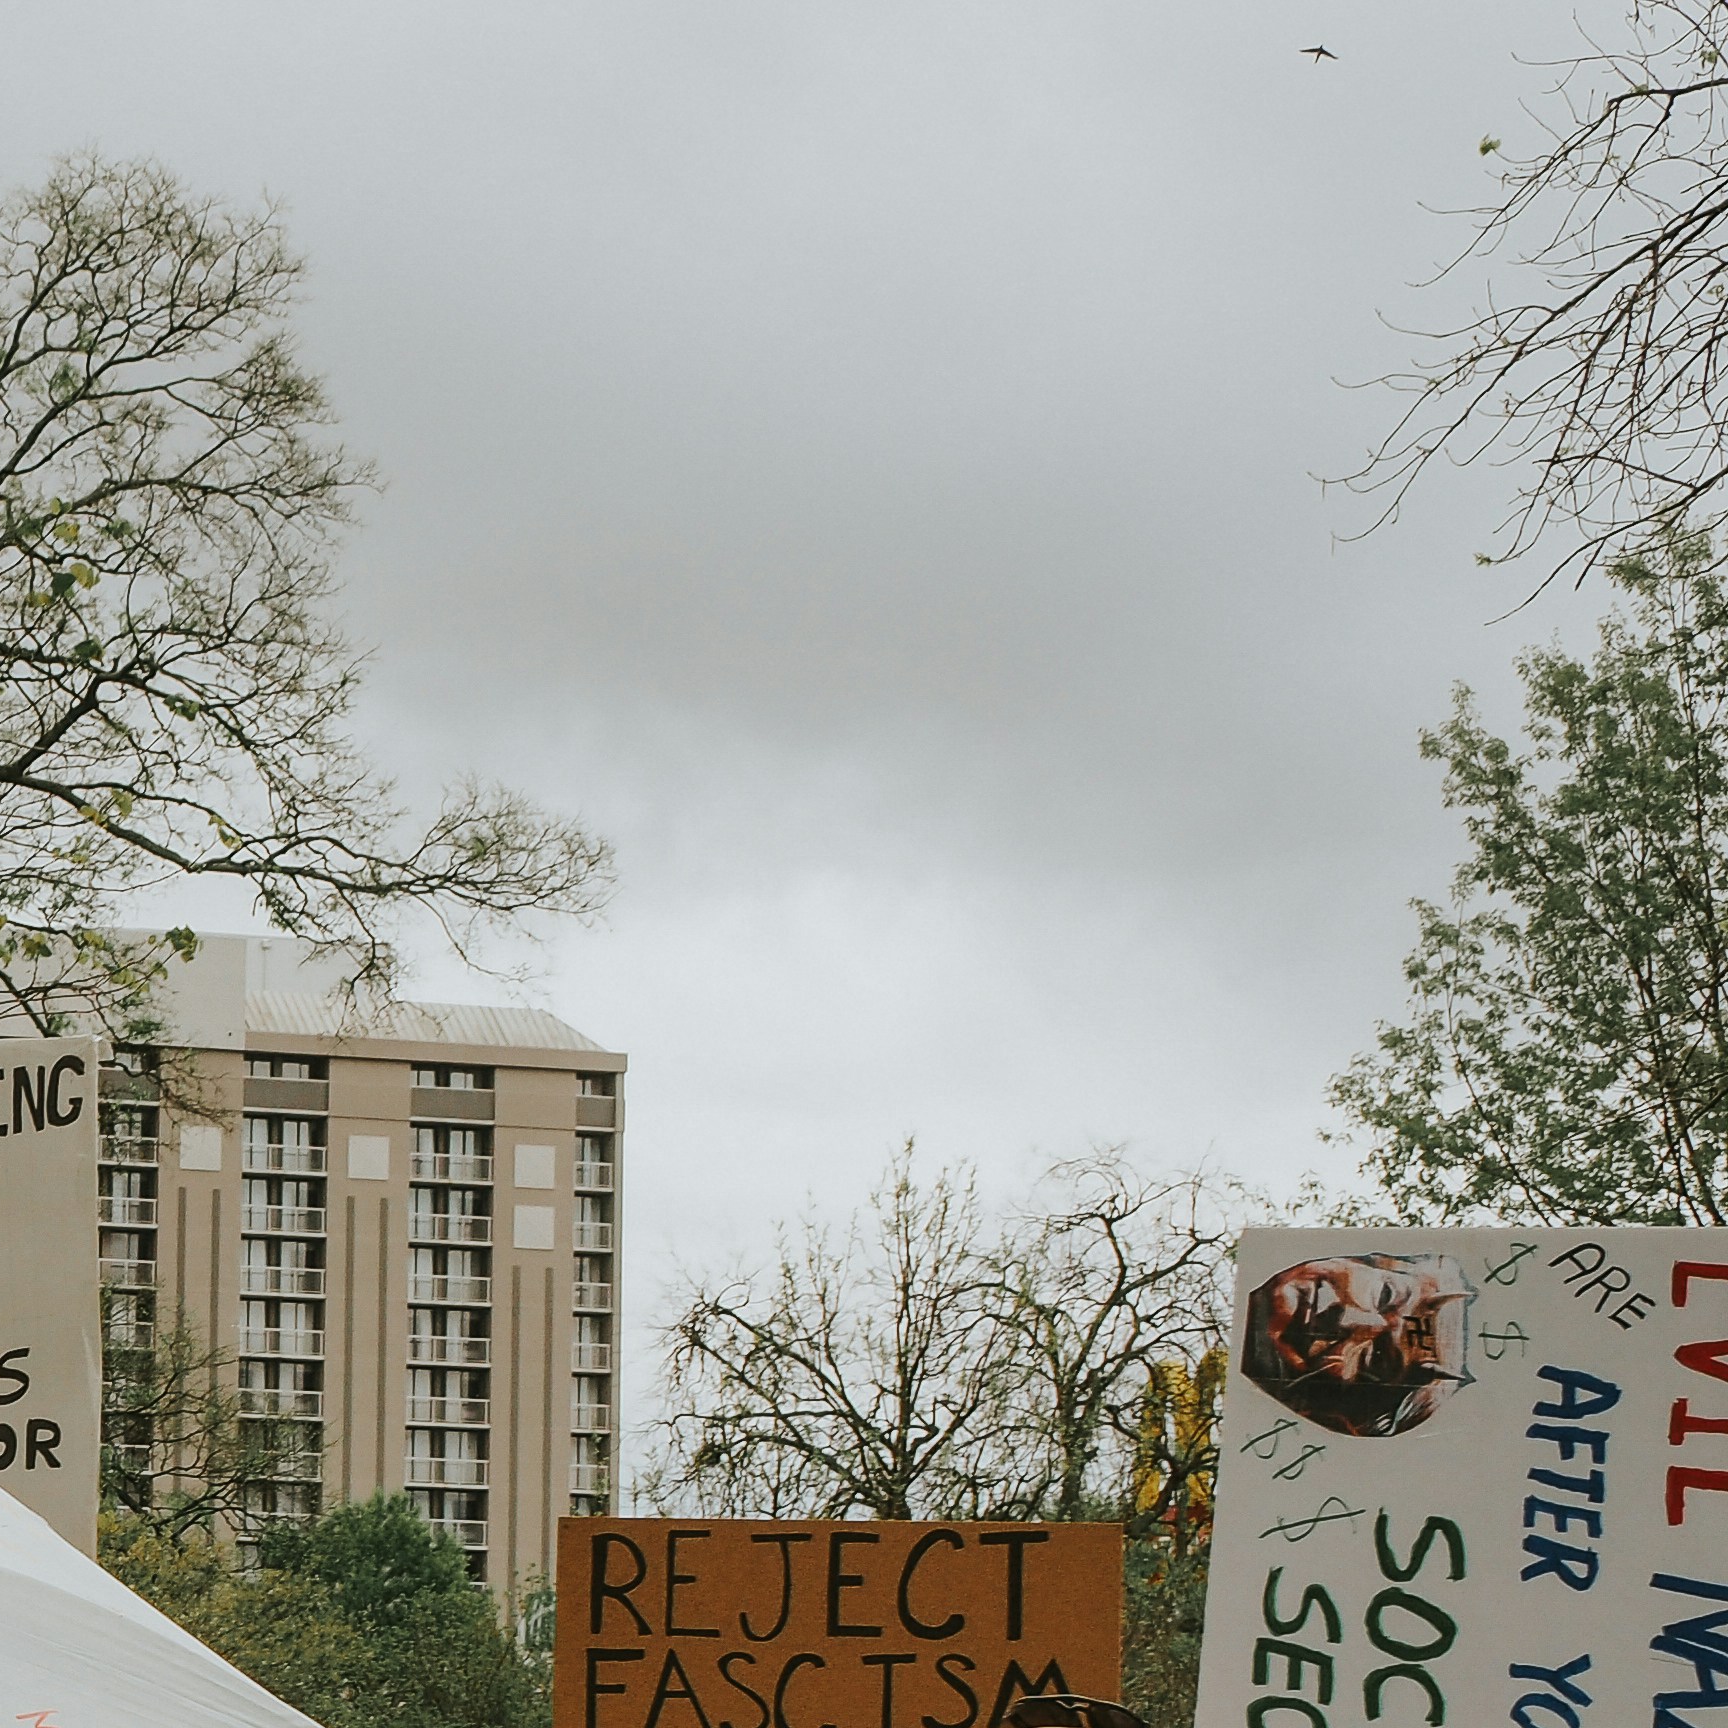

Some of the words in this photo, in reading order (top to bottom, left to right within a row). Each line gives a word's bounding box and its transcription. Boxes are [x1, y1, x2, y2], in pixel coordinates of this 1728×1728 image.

[1548, 1242, 1656, 1330] ARE
[1519, 1365, 1621, 1592] AFTER
[591, 1529, 1049, 1642] REJECT
